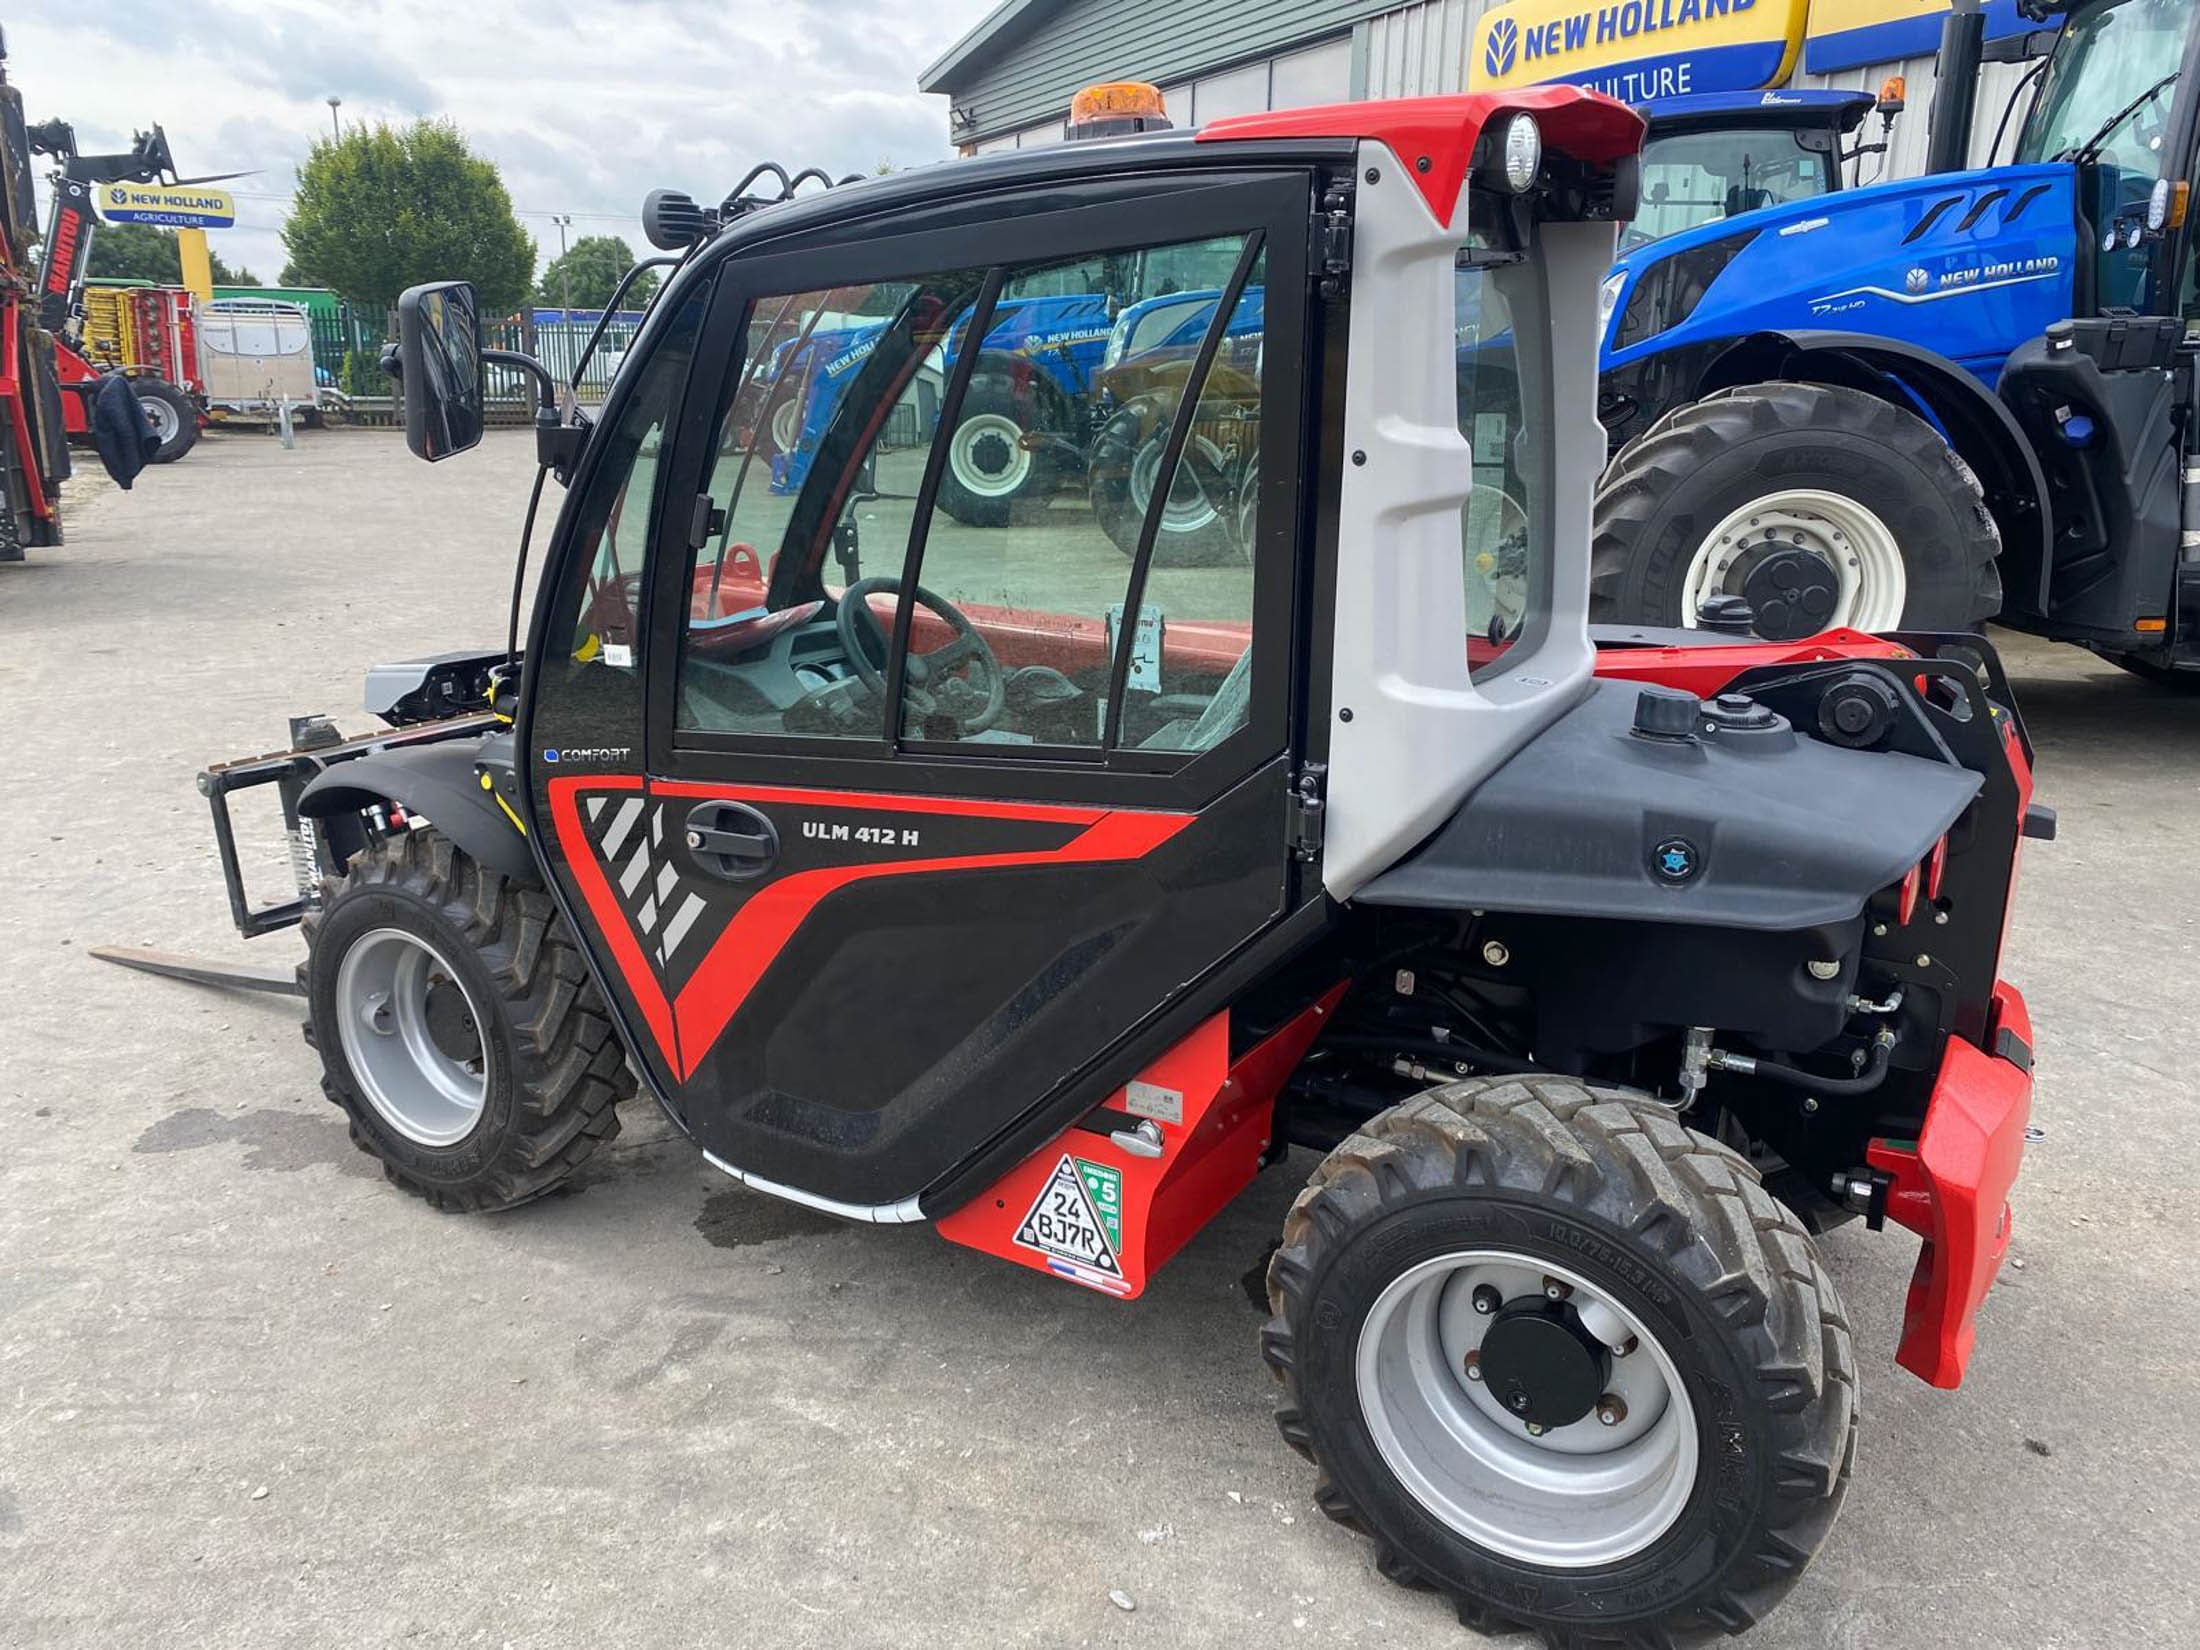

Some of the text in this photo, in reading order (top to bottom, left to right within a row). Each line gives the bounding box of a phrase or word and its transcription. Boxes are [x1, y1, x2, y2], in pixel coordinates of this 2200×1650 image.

[1525, 11, 1590, 60] NEW
[131, 193, 223, 210] NEW HOLLAND
[133, 212, 205, 225] AGRICULTURE
[49, 207, 81, 294] MANITOU
[1940, 256, 2059, 285] NEW HOLLAND
[1047, 331, 1069, 343] NEW
[825, 353, 850, 375] NEW
[561, 748, 630, 762] COMFORT
[802, 821, 919, 847] ULM 412 H
[1101, 1181, 1117, 1203] 5
[1053, 1191, 1081, 1221] 24
[1037, 1212, 1096, 1256] BJ7R
